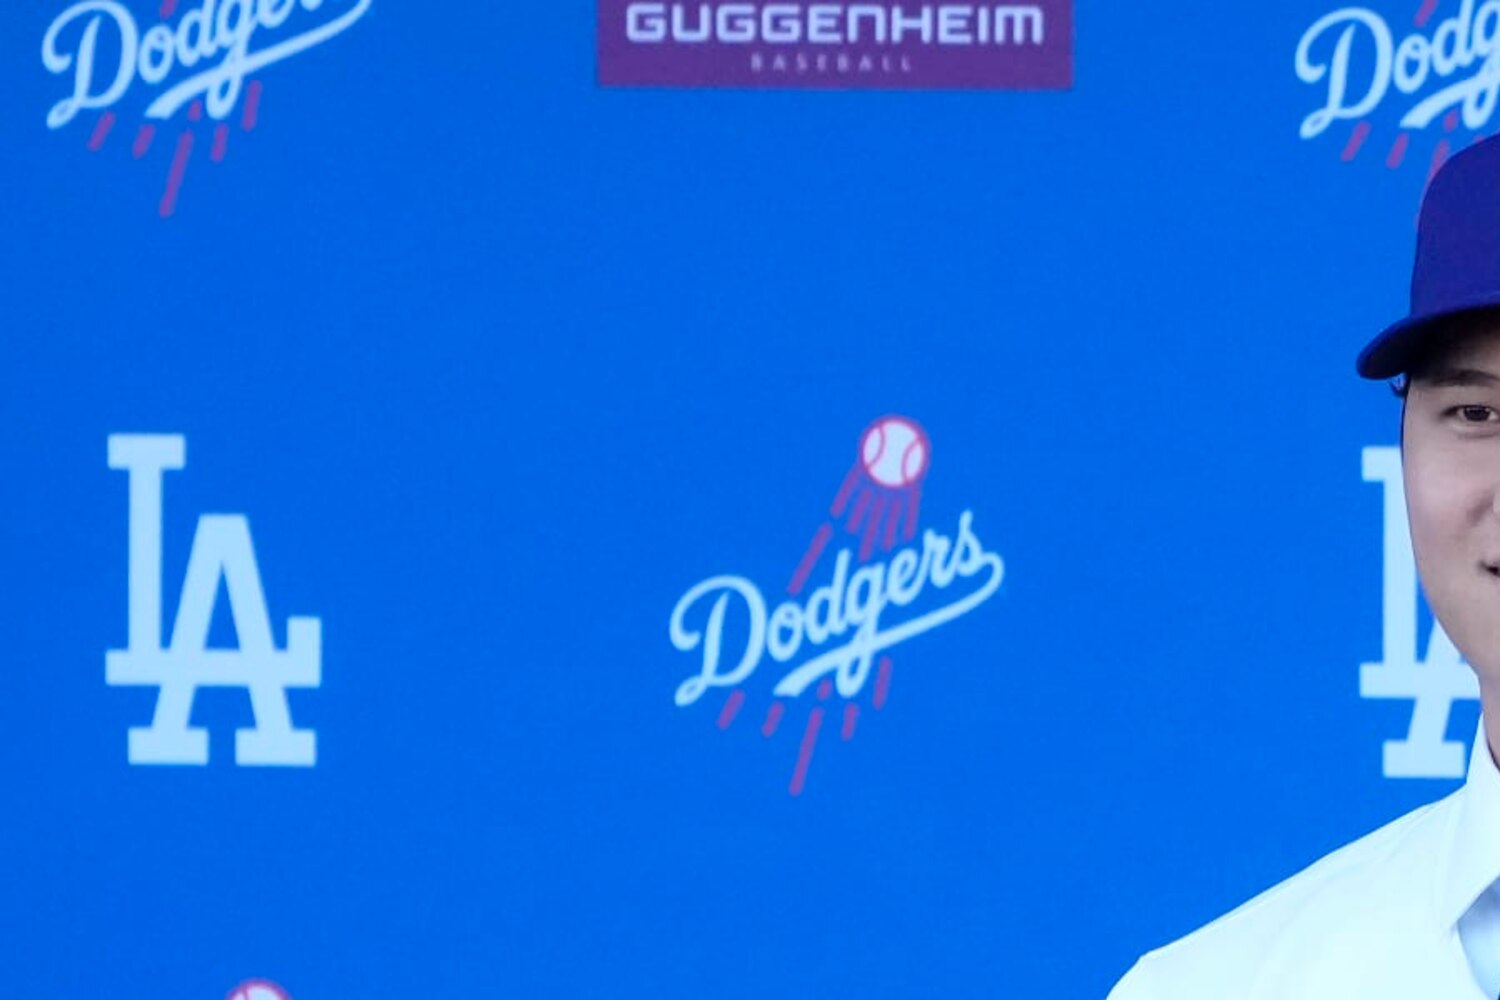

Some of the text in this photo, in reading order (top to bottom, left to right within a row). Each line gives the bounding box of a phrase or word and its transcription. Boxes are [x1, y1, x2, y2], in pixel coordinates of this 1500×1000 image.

[42, 0, 372, 128] Dodge
[625, 2, 1045, 45] GUGGENHEIM
[750, 53, 911, 73] BASEBALL
[105, 433, 322, 767] LA
[669, 511, 1004, 706] Dodgers
